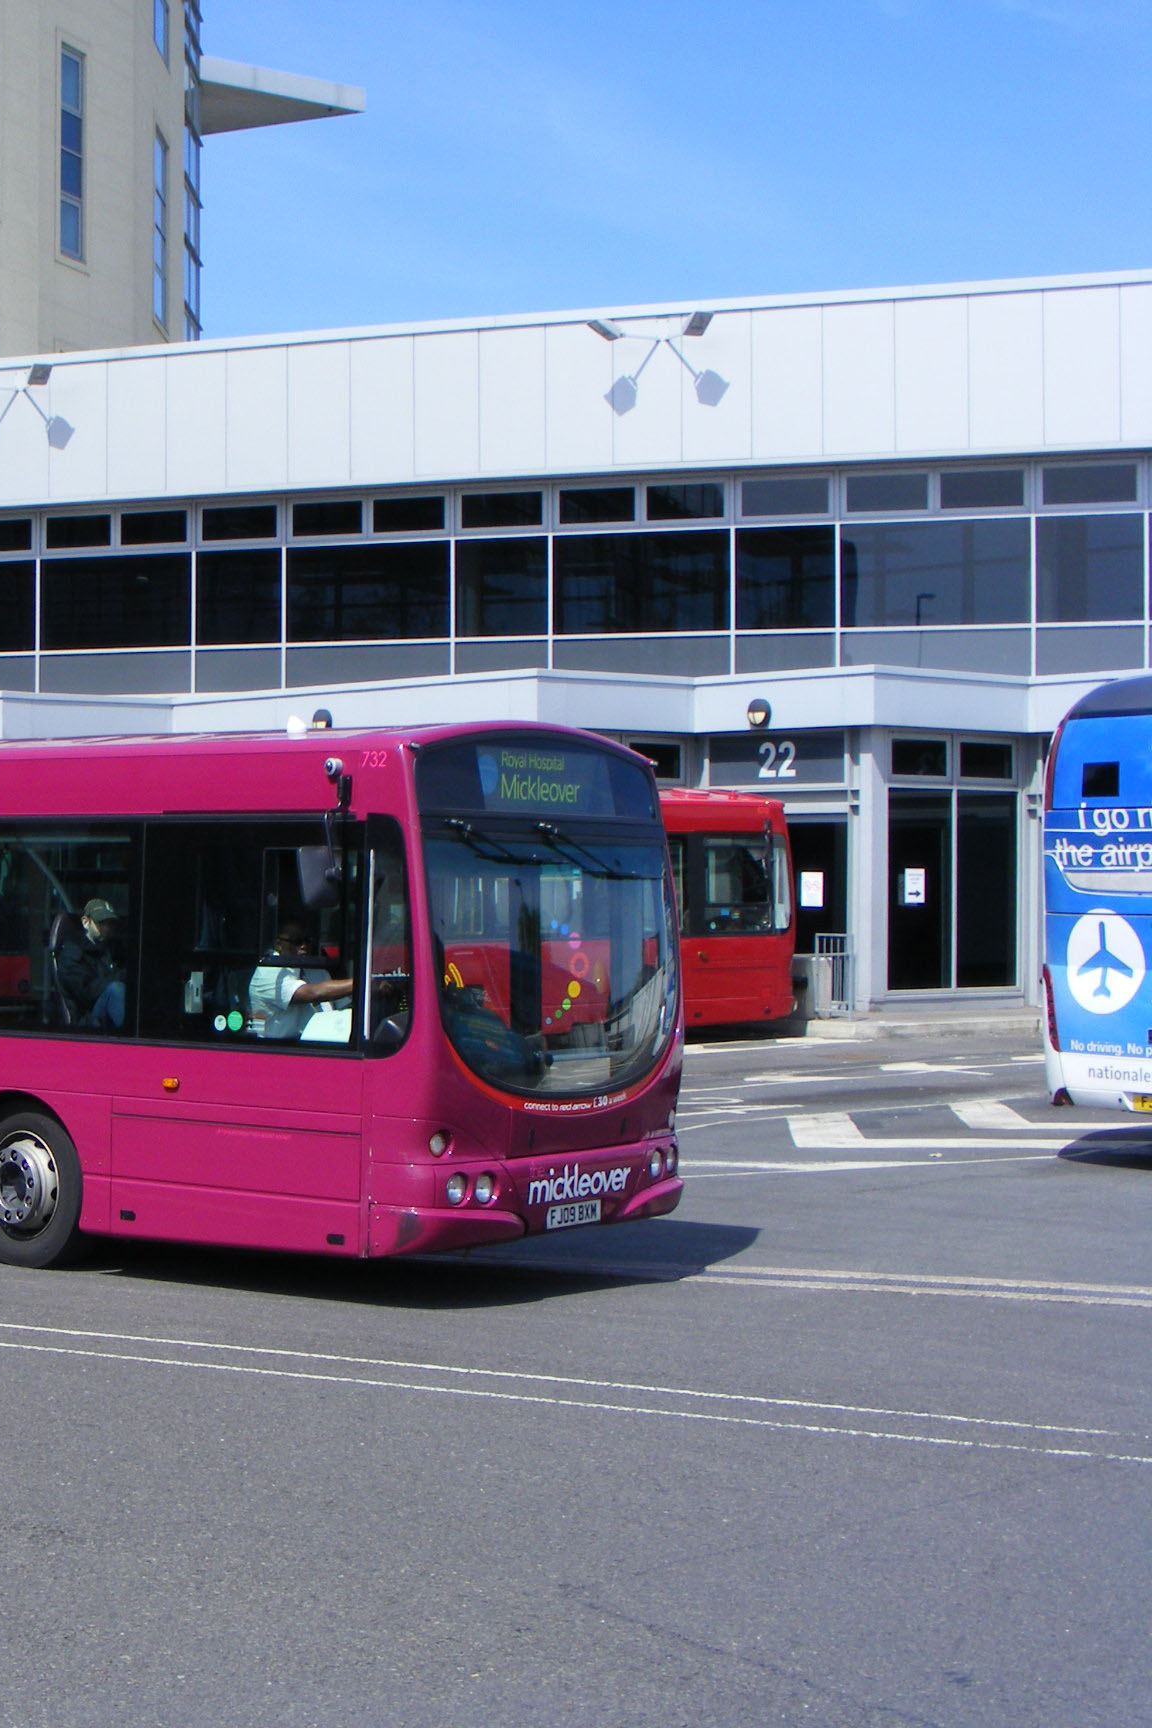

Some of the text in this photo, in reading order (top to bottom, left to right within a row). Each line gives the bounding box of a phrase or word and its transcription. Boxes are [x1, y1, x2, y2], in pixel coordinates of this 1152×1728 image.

[361, 751, 387, 768] 732
[501, 751, 565, 771] Royal Hospital
[758, 741, 797, 778] 22
[500, 774, 580, 803] Mickleover
[1078, 801, 1087, 830] i
[1093, 808, 1130, 837] go
[1055, 836, 1152, 872] the airp
[1070, 1039, 1085, 1051] No
[1087, 1040, 1124, 1056] driving.
[1127, 1042, 1143, 1055] No
[523, 1102, 551, 1111] connect
[551, 1103, 558, 1111] to
[559, 1102, 572, 1111] red
[572, 1103, 592, 1111] arrow
[593, 1095, 608, 1108] £30
[528, 1163, 631, 1205] mickleover
[550, 1203, 597, 1226] FJ09 BXM
